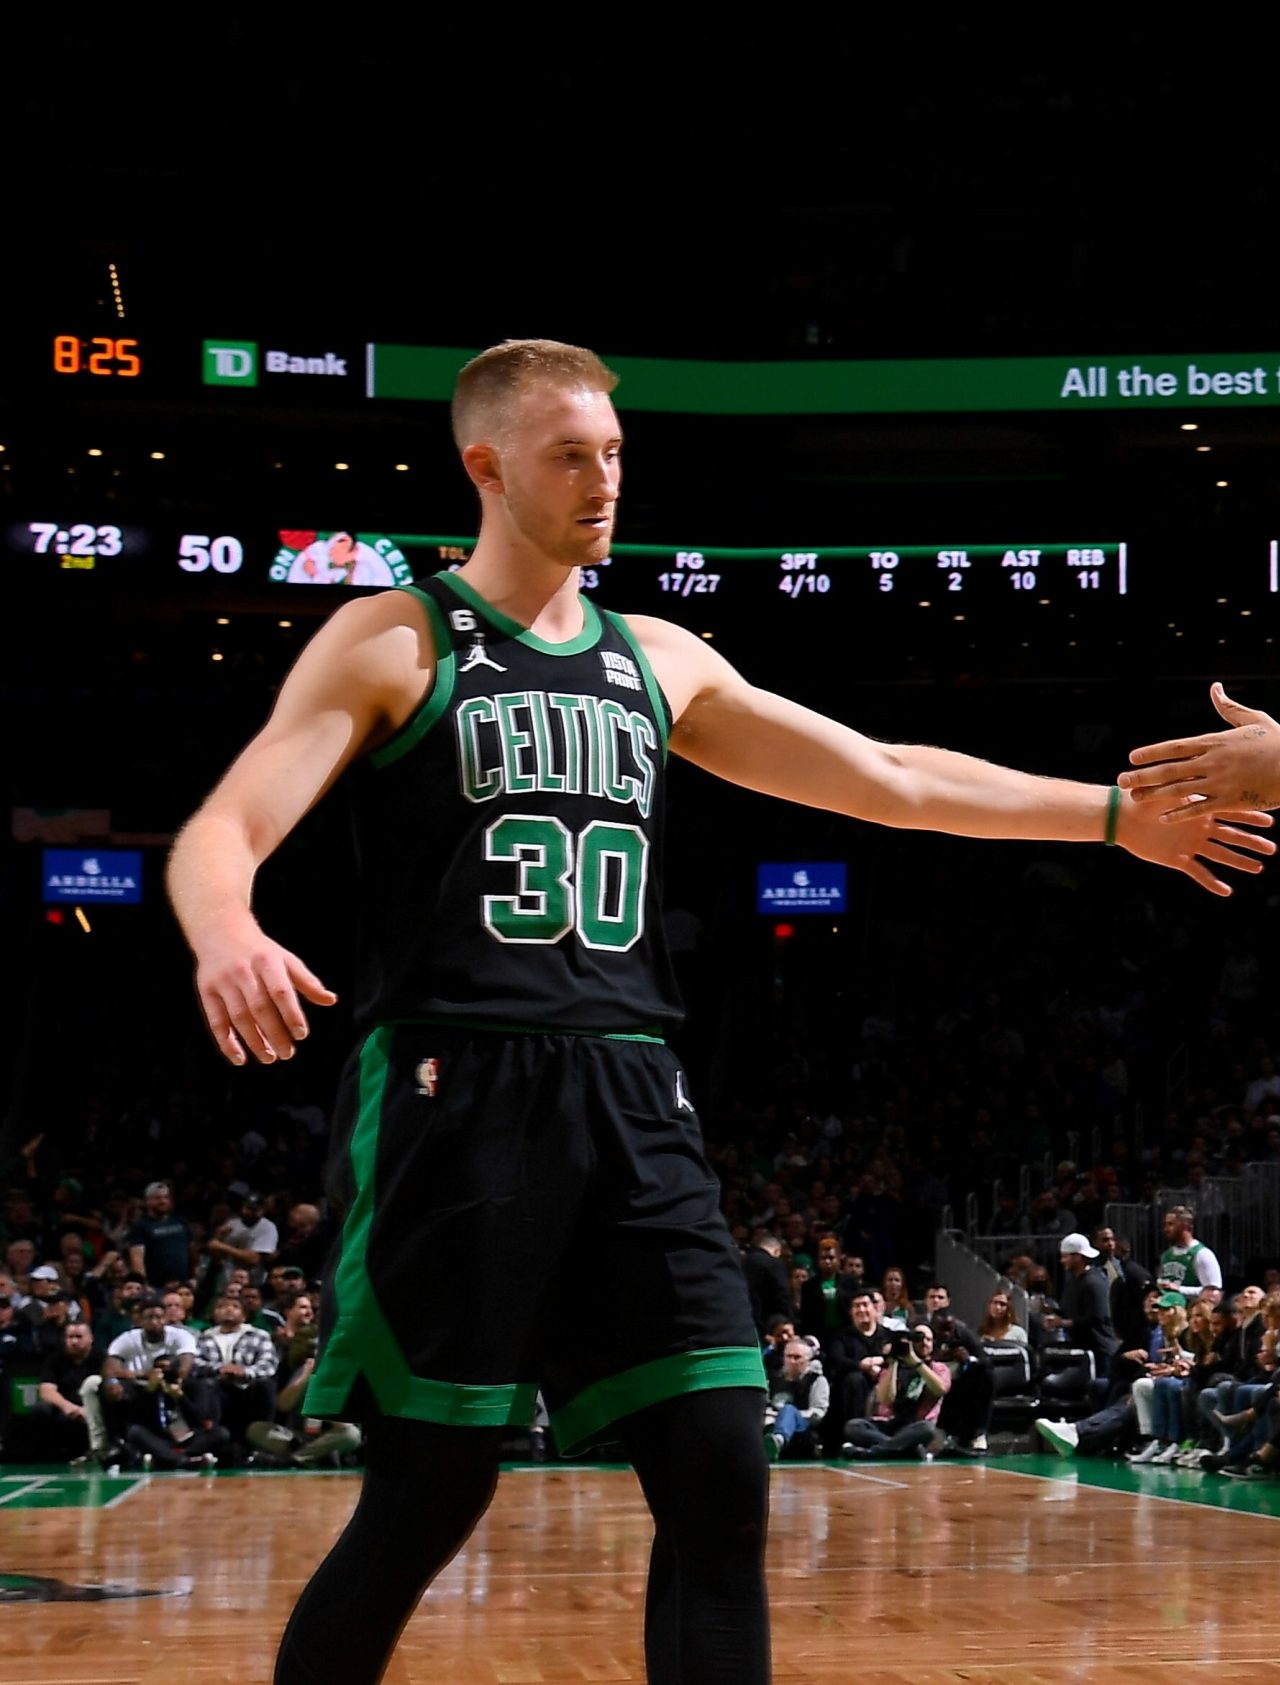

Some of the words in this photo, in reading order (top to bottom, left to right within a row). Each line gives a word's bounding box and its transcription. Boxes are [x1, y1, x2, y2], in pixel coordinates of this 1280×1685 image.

[54, 336, 140, 376] 8:25
[209, 348, 252, 377] TD
[267, 351, 346, 375] Bank
[1061, 367, 1106, 397] All
[1118, 366, 1177, 396] the
[1188, 365, 1267, 395] best
[30, 523, 122, 555] 7:23
[179, 535, 242, 573] 50
[676, 552, 704, 569] FG
[781, 553, 817, 570] 3PT
[869, 552, 898, 568] TO
[938, 551, 971, 567] STL
[1002, 550, 1041, 566] AST
[1067, 549, 1105, 566] REB
[659, 573, 720, 596] 17/27
[779, 575, 830, 598] 4/10
[880, 574, 892, 591] 5
[949, 573, 961, 590] 2
[1011, 572, 1035, 589] 10
[1078, 571, 1098, 588] 11
[450, 609, 477, 631] 6
[456, 691, 658, 819] CELTICS
[481, 814, 650, 952] 30
